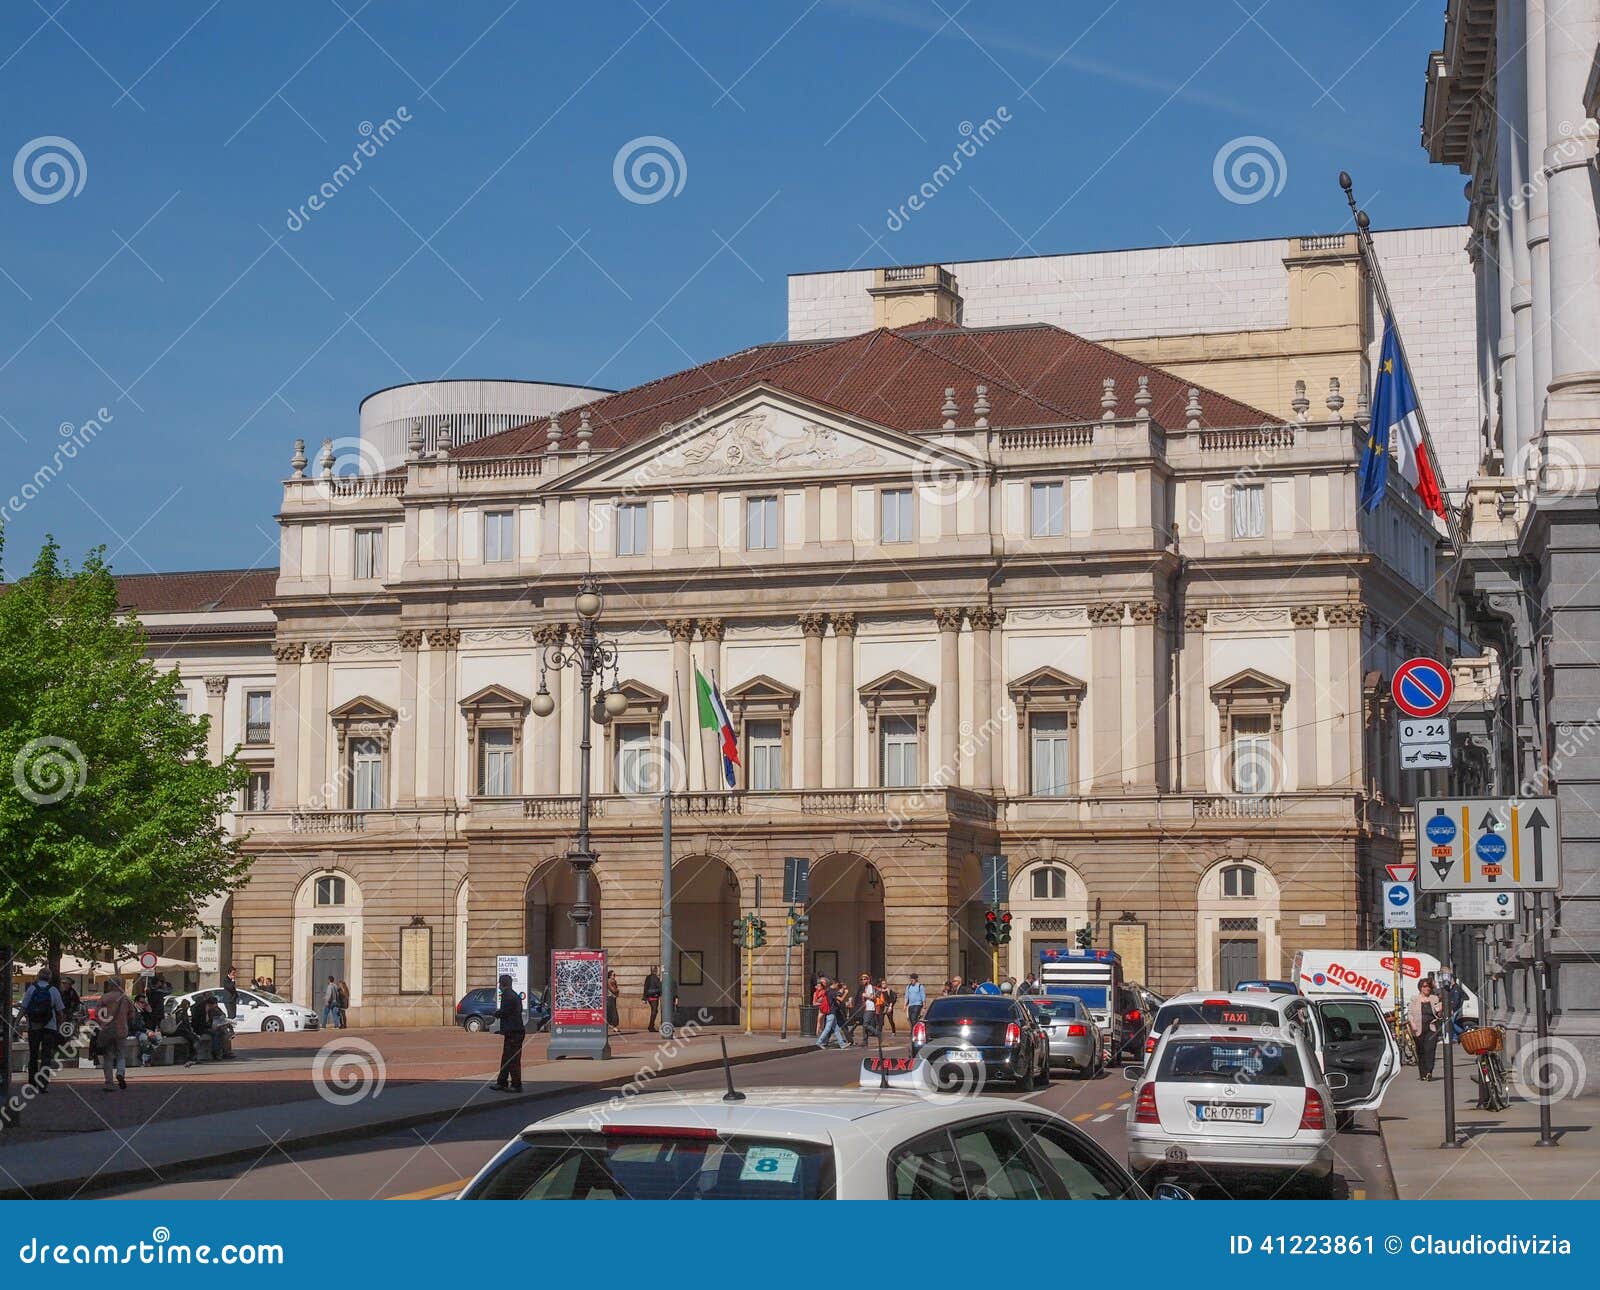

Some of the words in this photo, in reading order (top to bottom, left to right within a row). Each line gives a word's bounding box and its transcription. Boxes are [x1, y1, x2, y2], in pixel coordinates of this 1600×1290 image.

[1426, 725, 1445, 737] 24
[1327, 963, 1389, 1000] MORINI
[1223, 1013, 1248, 1022] TAXI
[871, 1057, 916, 1071] TAXI
[755, 1158, 779, 1172] 8
